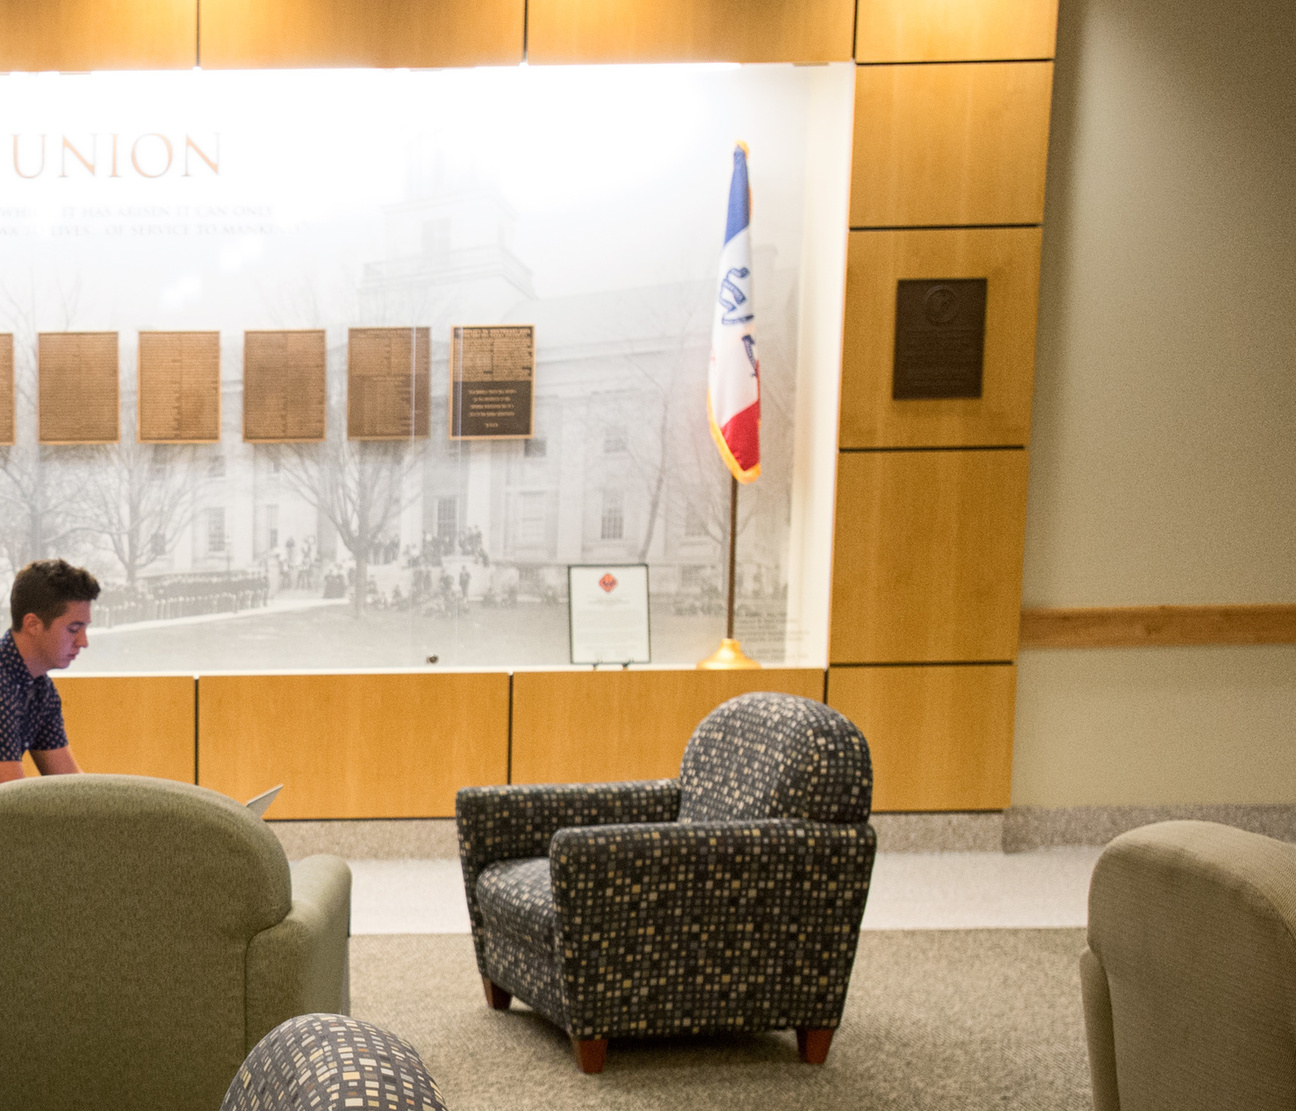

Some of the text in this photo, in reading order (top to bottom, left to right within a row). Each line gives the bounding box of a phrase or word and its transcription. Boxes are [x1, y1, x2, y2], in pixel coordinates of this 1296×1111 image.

[10, 132, 222, 179] UNION
[194, 204, 228, 219] CAN
[130, 224, 190, 239] SERVICE
[196, 224, 218, 238] TO
